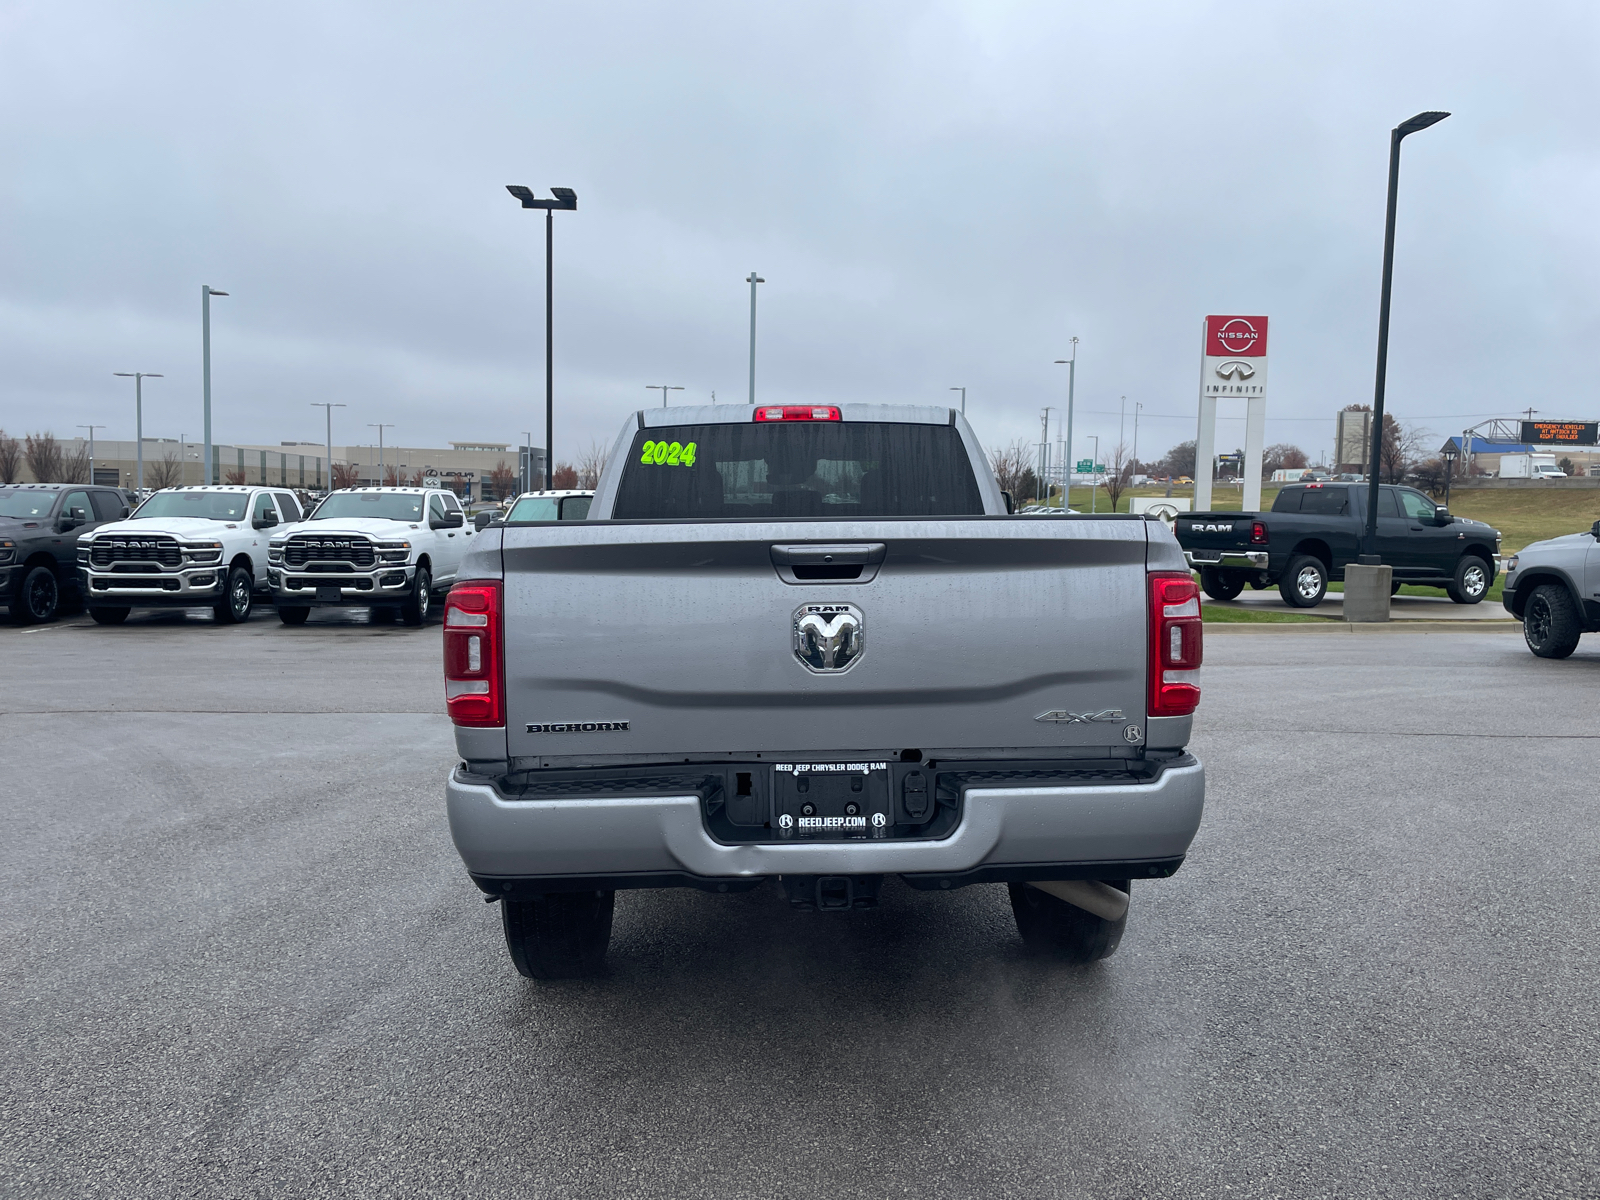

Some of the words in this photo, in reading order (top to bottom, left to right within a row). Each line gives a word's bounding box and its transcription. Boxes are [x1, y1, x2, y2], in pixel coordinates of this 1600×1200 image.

[1206, 385, 1263, 393] INFINITI
[641, 440, 697, 467] 2024
[1192, 524, 1232, 532] RAM
[526, 721, 630, 733] BIGHORN
[846, 763, 869, 771] DODGE
[798, 817, 866, 827] REEDJEEP.COM
